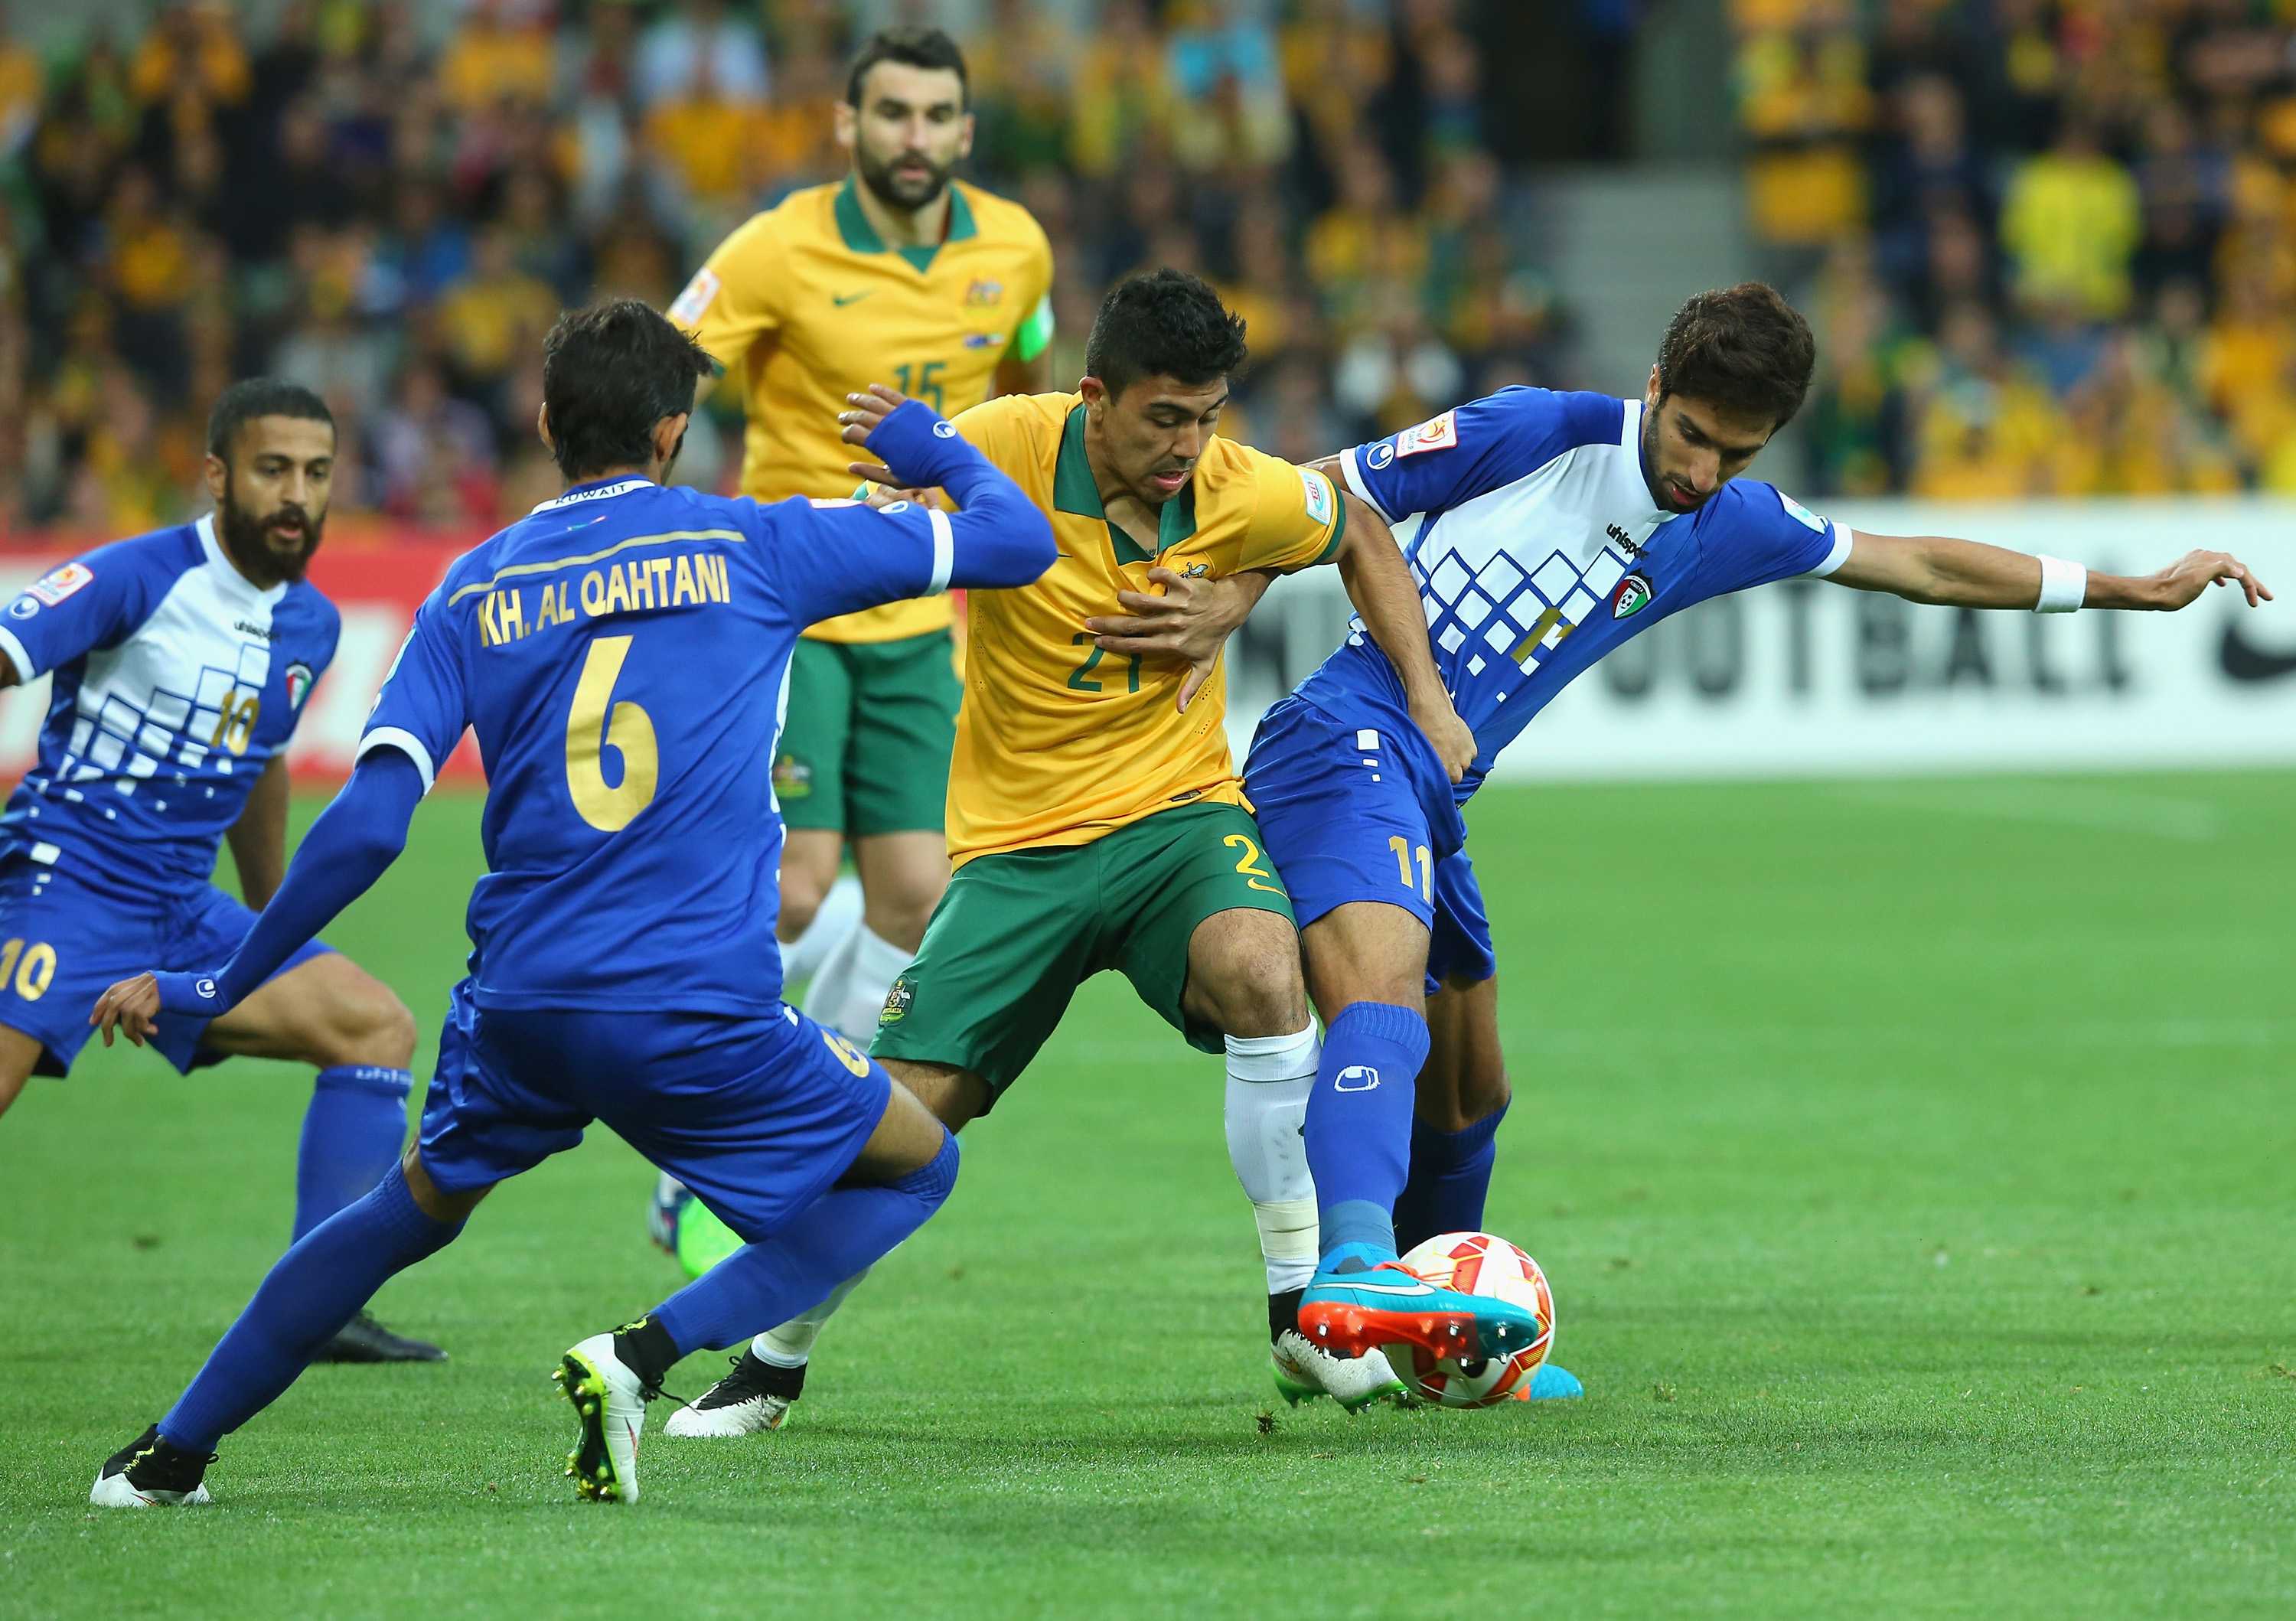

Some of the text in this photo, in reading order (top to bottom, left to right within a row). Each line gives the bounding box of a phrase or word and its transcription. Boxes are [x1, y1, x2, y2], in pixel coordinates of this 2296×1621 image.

[893, 362, 946, 416] 15
[555, 484, 626, 505] KUWAIT
[478, 553, 730, 647] KH. AL QAHTANI
[1067, 631, 1142, 694] 21
[210, 691, 260, 757] 10
[565, 634, 659, 833] 6
[1388, 835, 1430, 906] 11
[0, 938, 57, 1002] 10
[821, 1029, 869, 1078] 6
